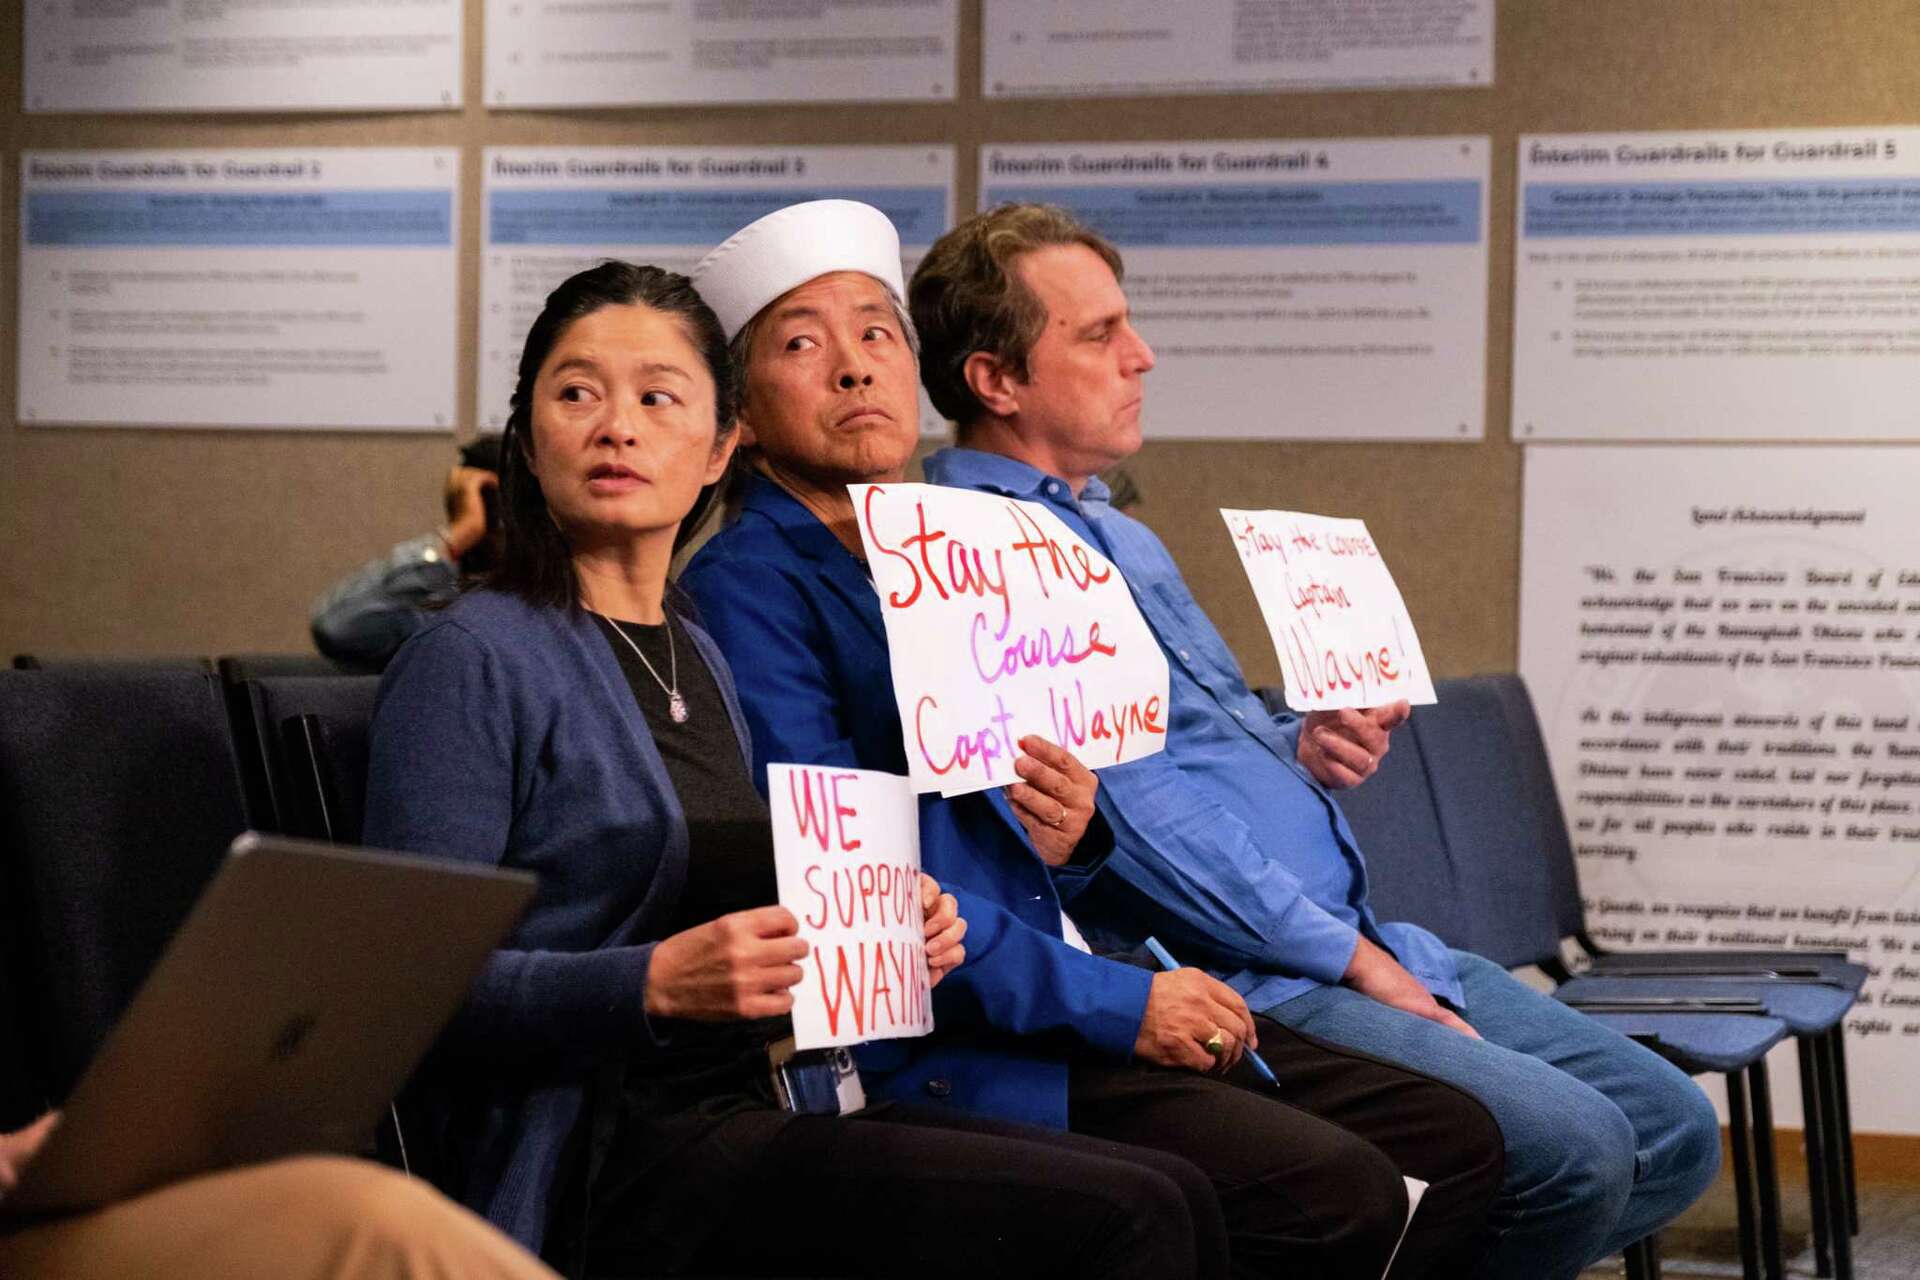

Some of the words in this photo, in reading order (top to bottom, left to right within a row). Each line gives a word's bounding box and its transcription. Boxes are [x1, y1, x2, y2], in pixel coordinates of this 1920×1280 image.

[1179, 153, 1206, 172] for
[1530, 143, 1609, 166] Interim
[1617, 144, 1728, 163] Guardrails
[1736, 142, 1764, 160] for
[1773, 139, 1876, 162] Guardrail
[866, 486, 1010, 641] Stay
[1006, 500, 1111, 599] the
[1233, 516, 1288, 565] Stay
[1290, 524, 1321, 553] the
[1285, 573, 1351, 620] Captain
[971, 611, 1116, 684] Course
[1280, 615, 1412, 704] Wayne!
[1049, 678, 1165, 765] Wayne
[789, 769, 862, 852] WE
[814, 940, 926, 1037] WAYN
